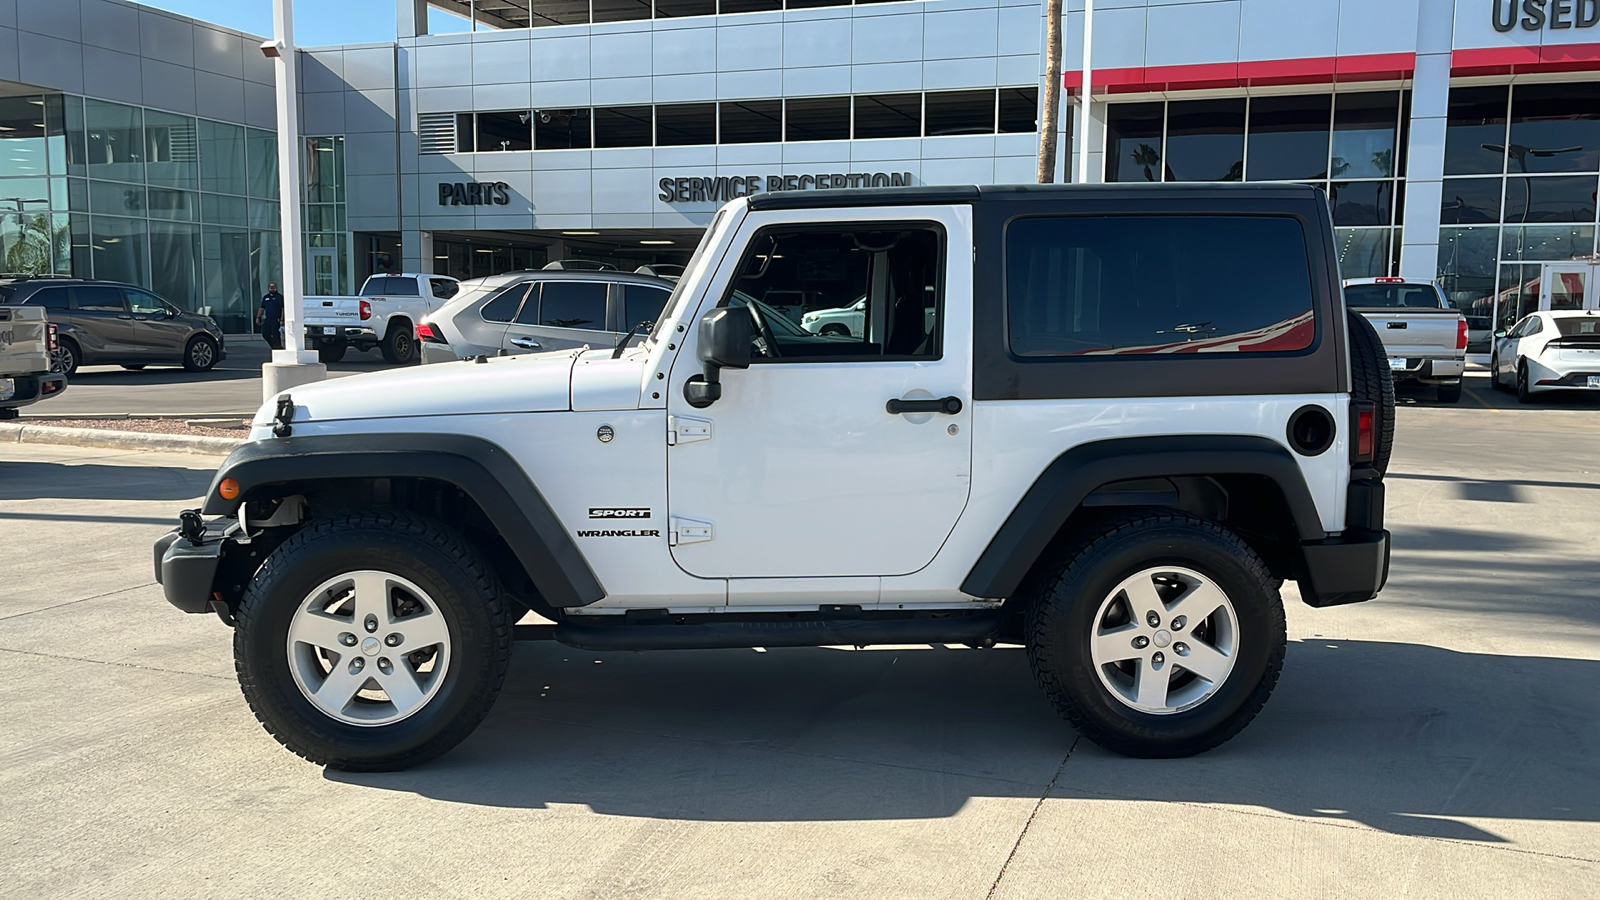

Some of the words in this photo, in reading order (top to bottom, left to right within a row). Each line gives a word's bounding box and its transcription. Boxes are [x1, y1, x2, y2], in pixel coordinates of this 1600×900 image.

[1492, 0, 1600, 32] USED
[438, 181, 510, 206] PARTS
[658, 175, 760, 202] SERVICE
[589, 508, 651, 518] SPORT
